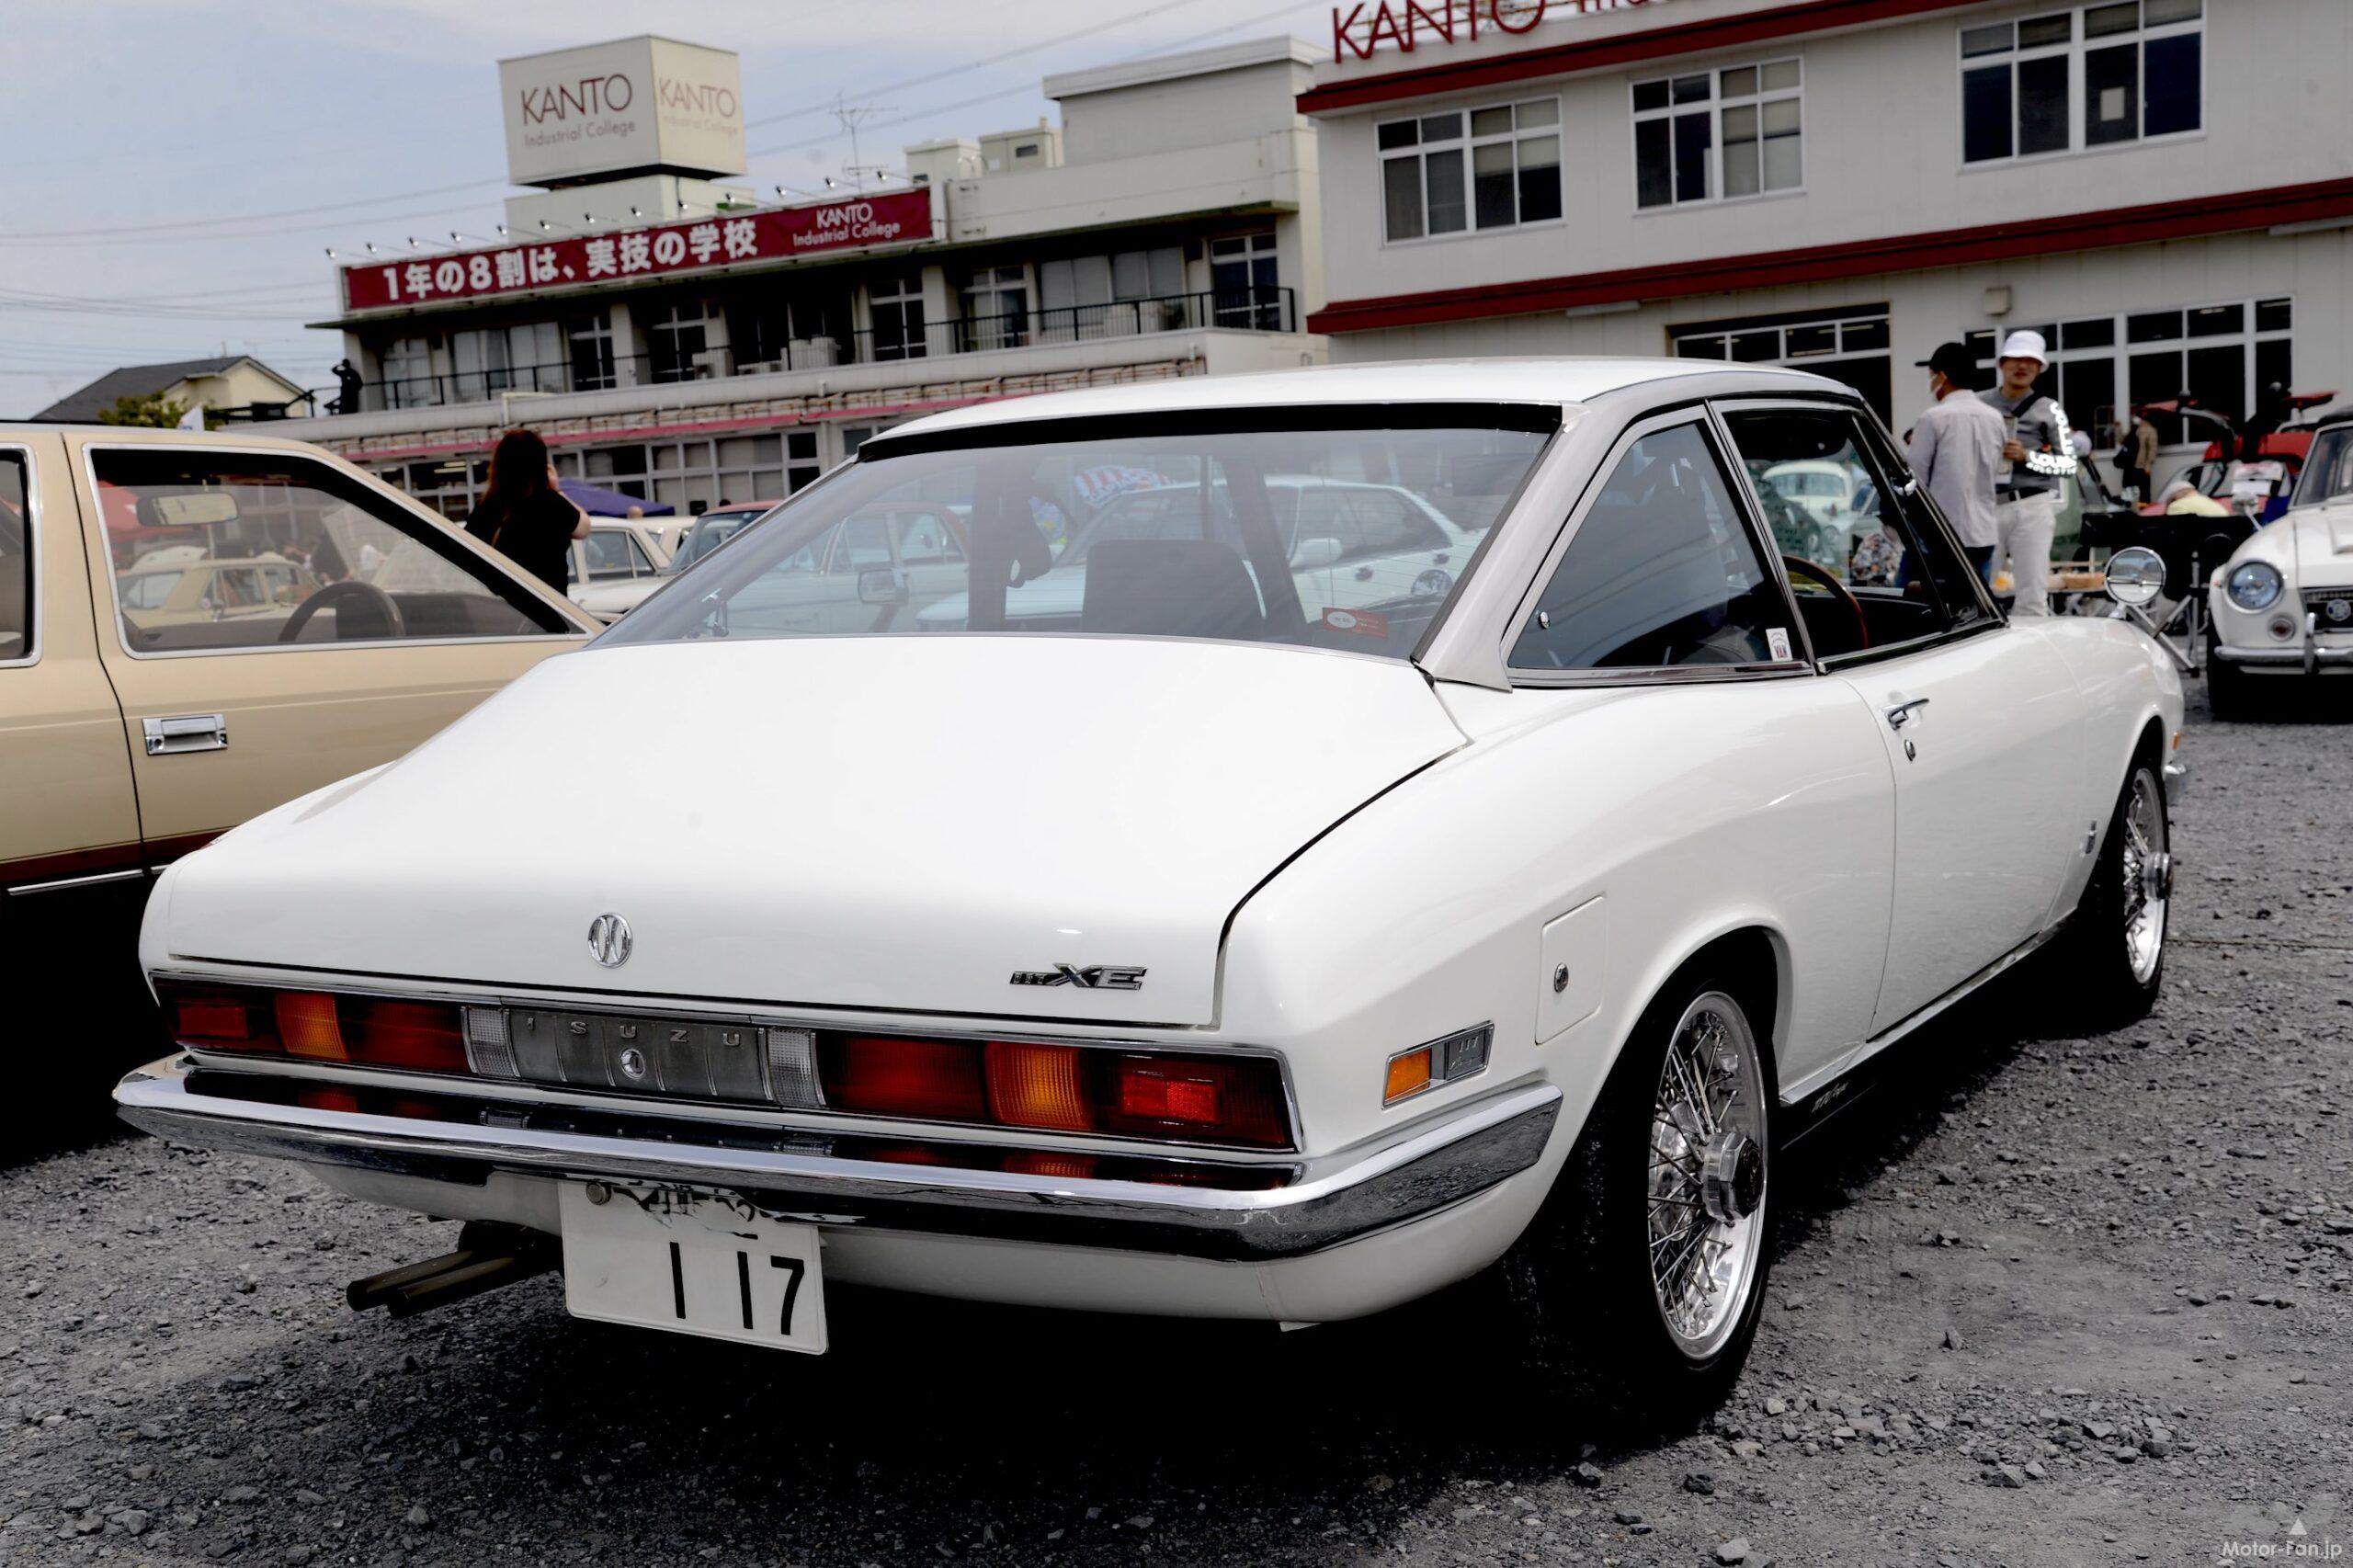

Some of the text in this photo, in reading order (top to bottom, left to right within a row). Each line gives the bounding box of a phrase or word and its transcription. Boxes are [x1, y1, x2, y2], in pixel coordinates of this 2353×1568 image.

[1332, 0, 1546, 64] KANTO
[520, 74, 632, 126] KANTO
[658, 76, 737, 119] KANTO
[525, 119, 636, 147] Industrial College
[792, 221, 901, 246] Industrial College
[816, 203, 873, 228] KANTO
[382, 219, 758, 301] 1年の8割は、実技の学校
[527, 1017, 740, 1046] ISUZU
